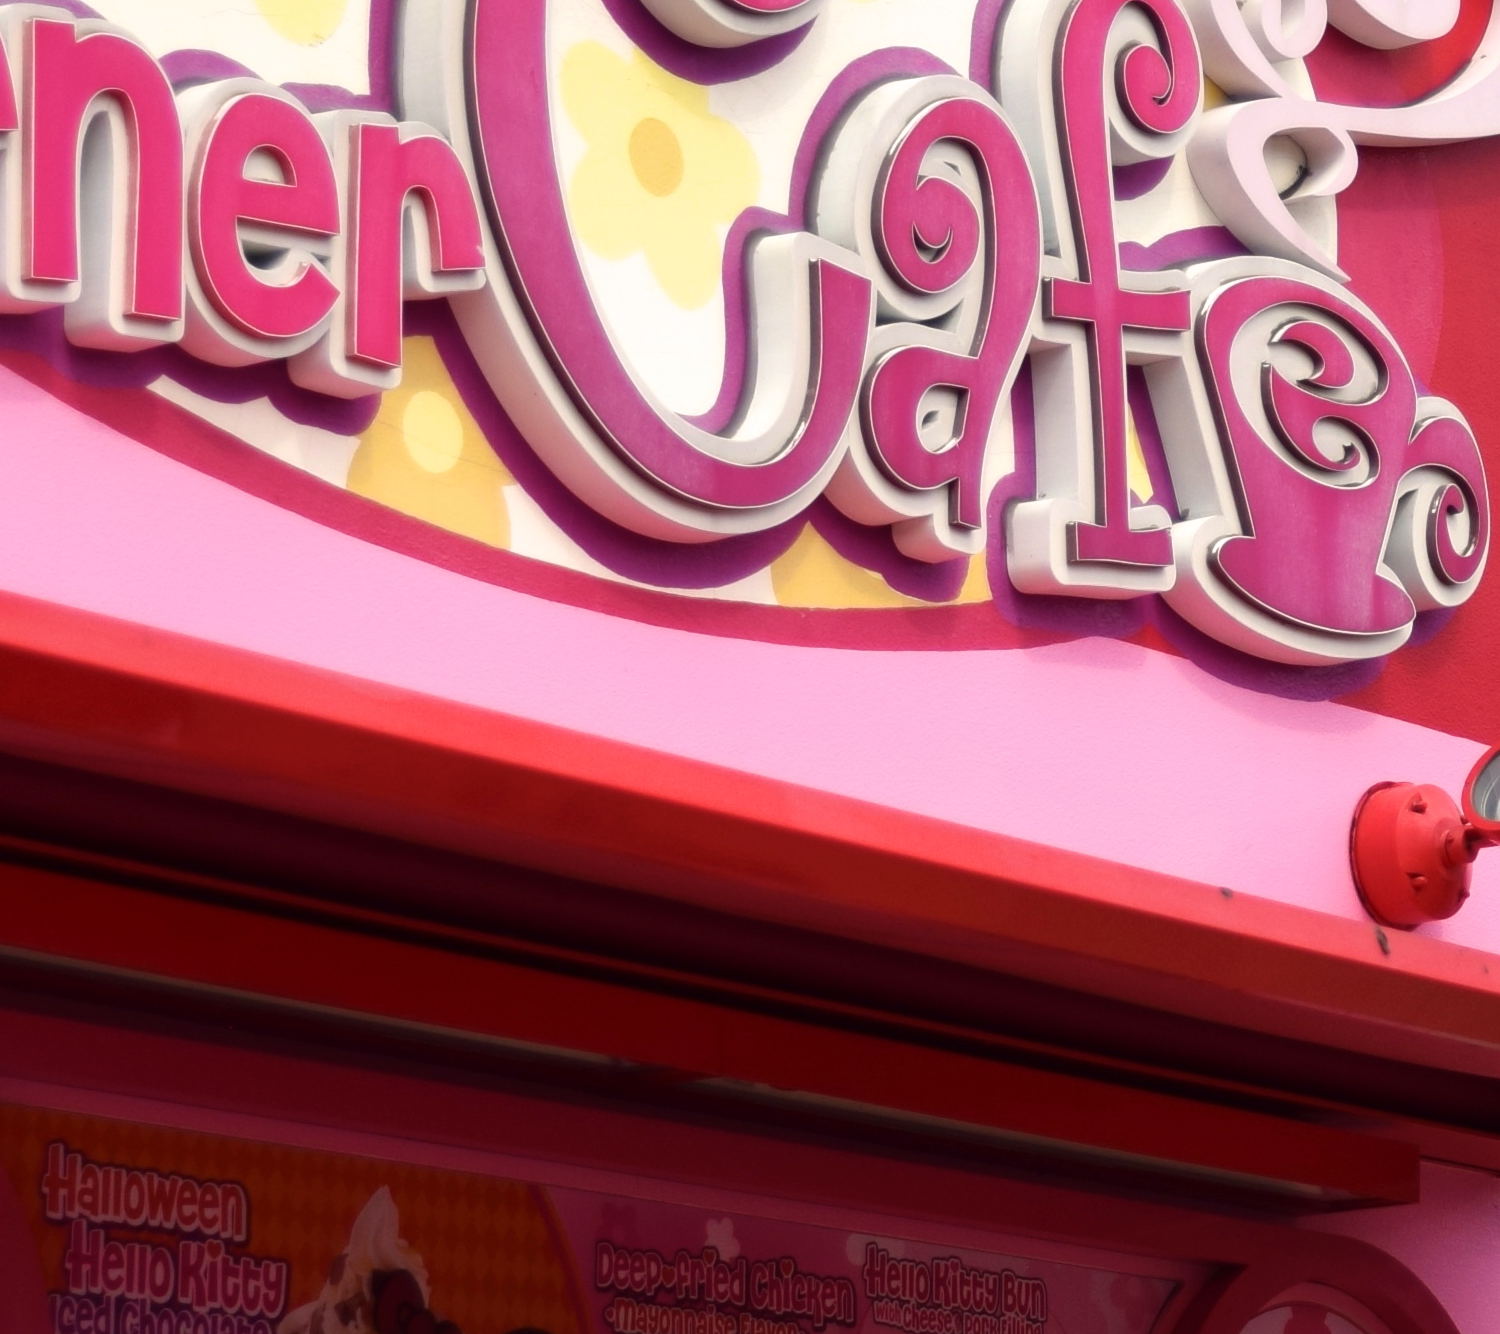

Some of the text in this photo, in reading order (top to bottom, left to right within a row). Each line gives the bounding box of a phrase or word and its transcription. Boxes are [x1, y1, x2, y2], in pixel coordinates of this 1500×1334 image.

[43, 1142, 247, 1242] Halloween
[66, 1219, 286, 1317] Hello Kitty
[749, 1259, 855, 1327] Chicken
[863, 1244, 1047, 1321] Hello Kitty Bun
[874, 1299, 902, 1327] with
